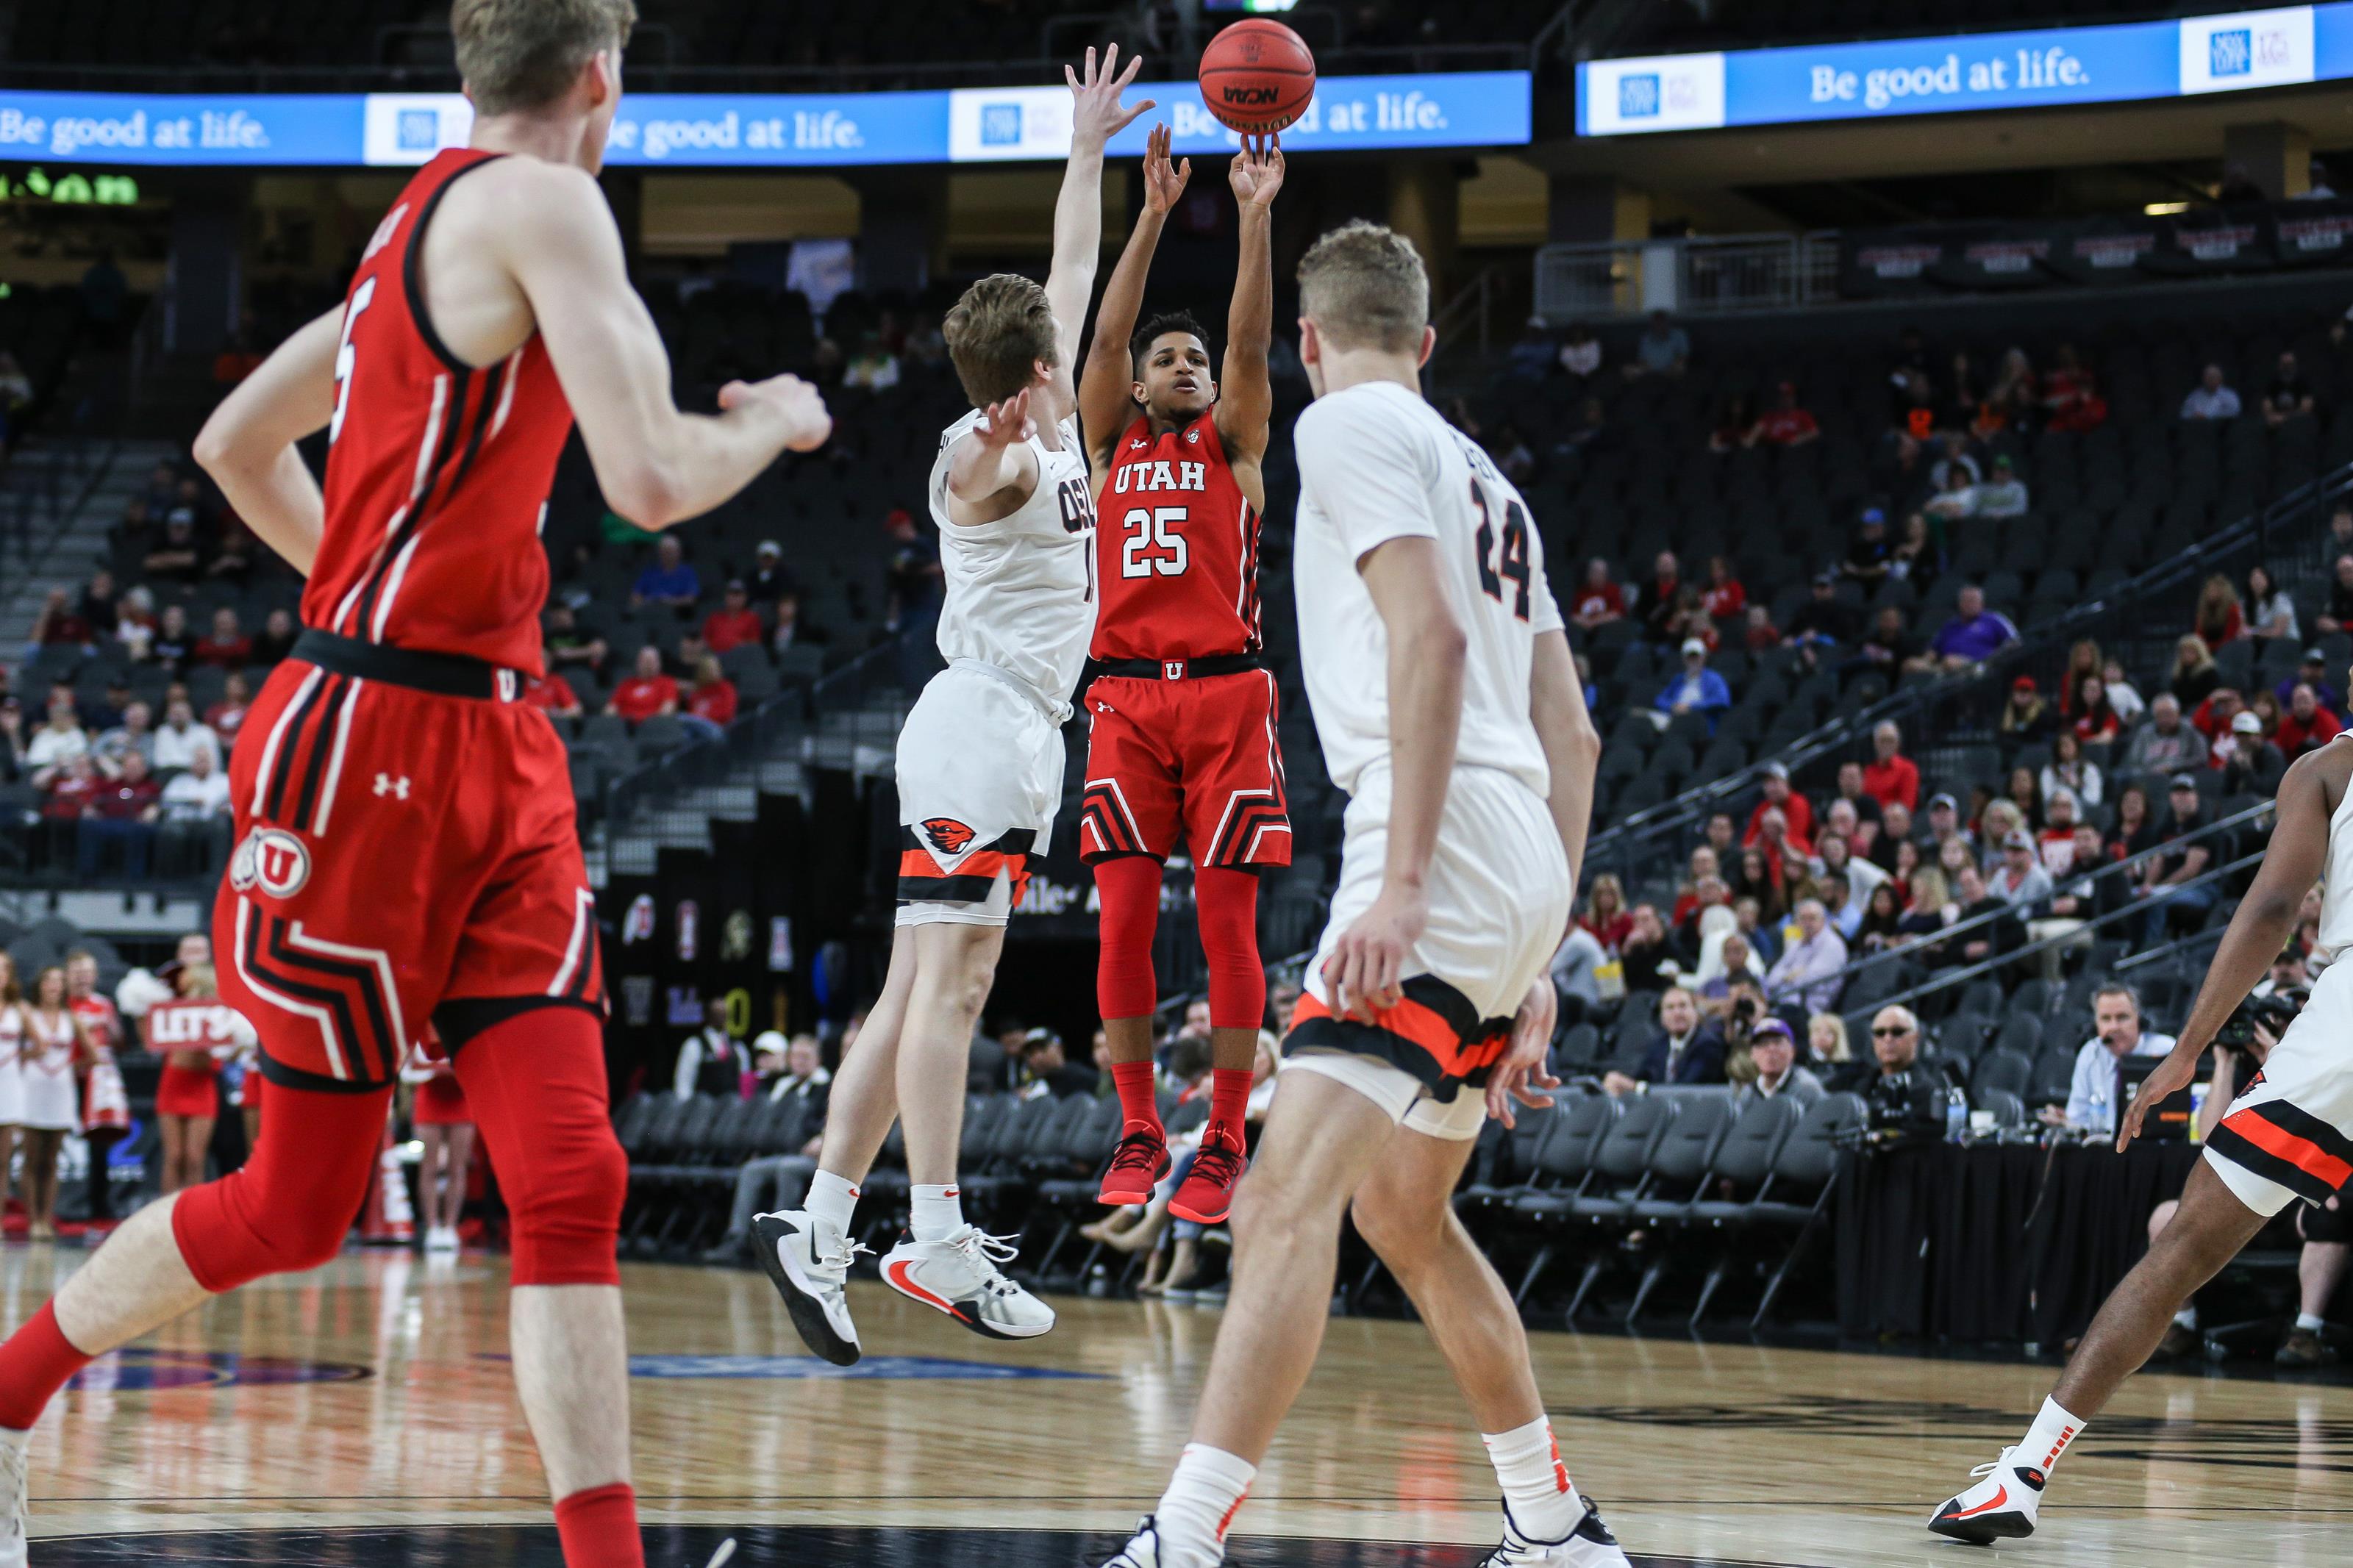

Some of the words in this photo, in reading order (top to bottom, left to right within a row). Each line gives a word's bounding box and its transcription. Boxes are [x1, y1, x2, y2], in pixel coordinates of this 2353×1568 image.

[1224, 86, 1279, 104] NCAA
[1810, 65, 1858, 102] Be
[1864, 54, 1961, 110] good
[1968, 57, 2008, 92] at
[2016, 46, 2090, 89] life.
[0, 108, 46, 144] Be
[50, 109, 147, 156] good
[153, 118, 193, 148] at
[200, 109, 272, 148] life.
[1173, 101, 1217, 137] Be
[1328, 101, 1368, 132] at
[1377, 90, 1449, 132] life.
[642, 110, 739, 159] good
[745, 118, 786, 148] at
[793, 110, 865, 148] life.
[1114, 460, 1205, 494] UTAH
[1122, 506, 1188, 579] 25
[496, 667, 516, 703] U
[1165, 662, 1183, 680] U
[264, 842, 298, 886] U
